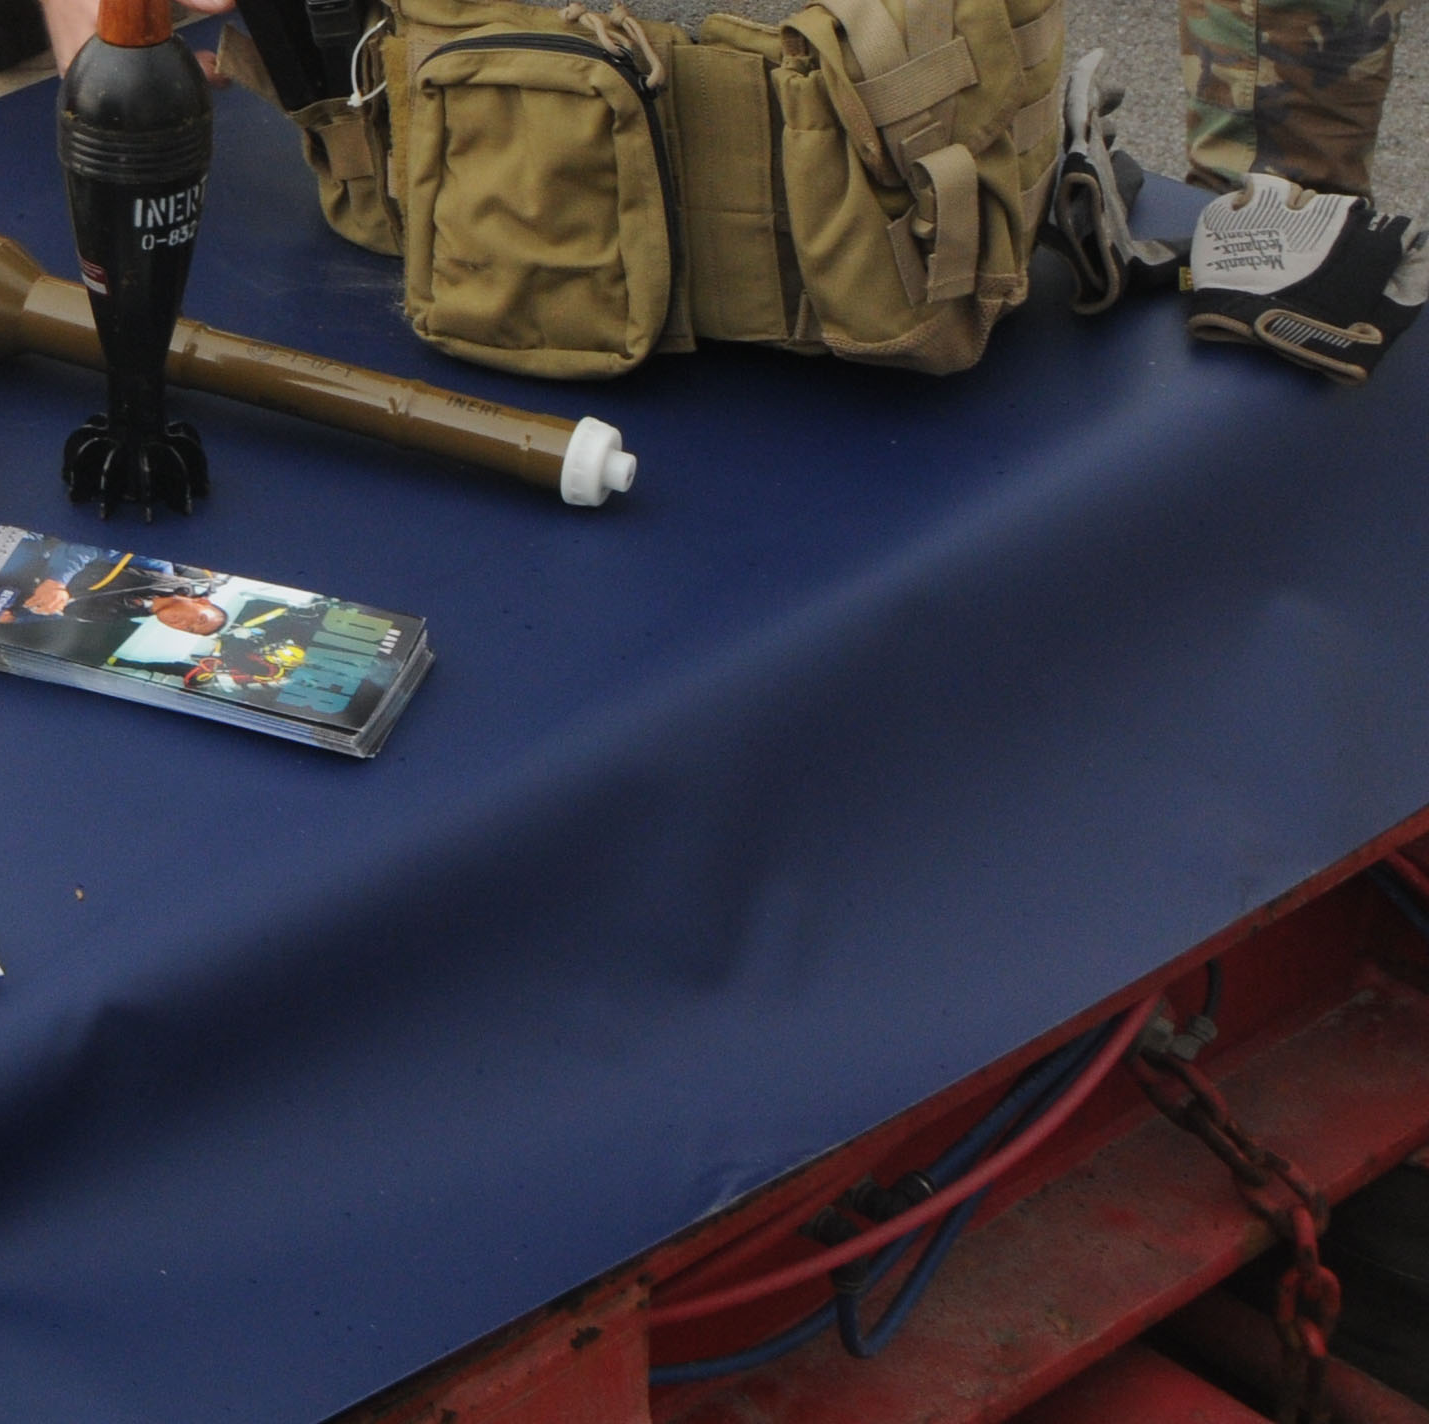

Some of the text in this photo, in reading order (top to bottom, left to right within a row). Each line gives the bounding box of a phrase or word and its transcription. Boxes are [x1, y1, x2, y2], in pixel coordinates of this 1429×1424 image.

[445, 395, 503, 418] INERT
[378, 628, 402, 655] NAVY
[276, 607, 394, 714] DIVER
